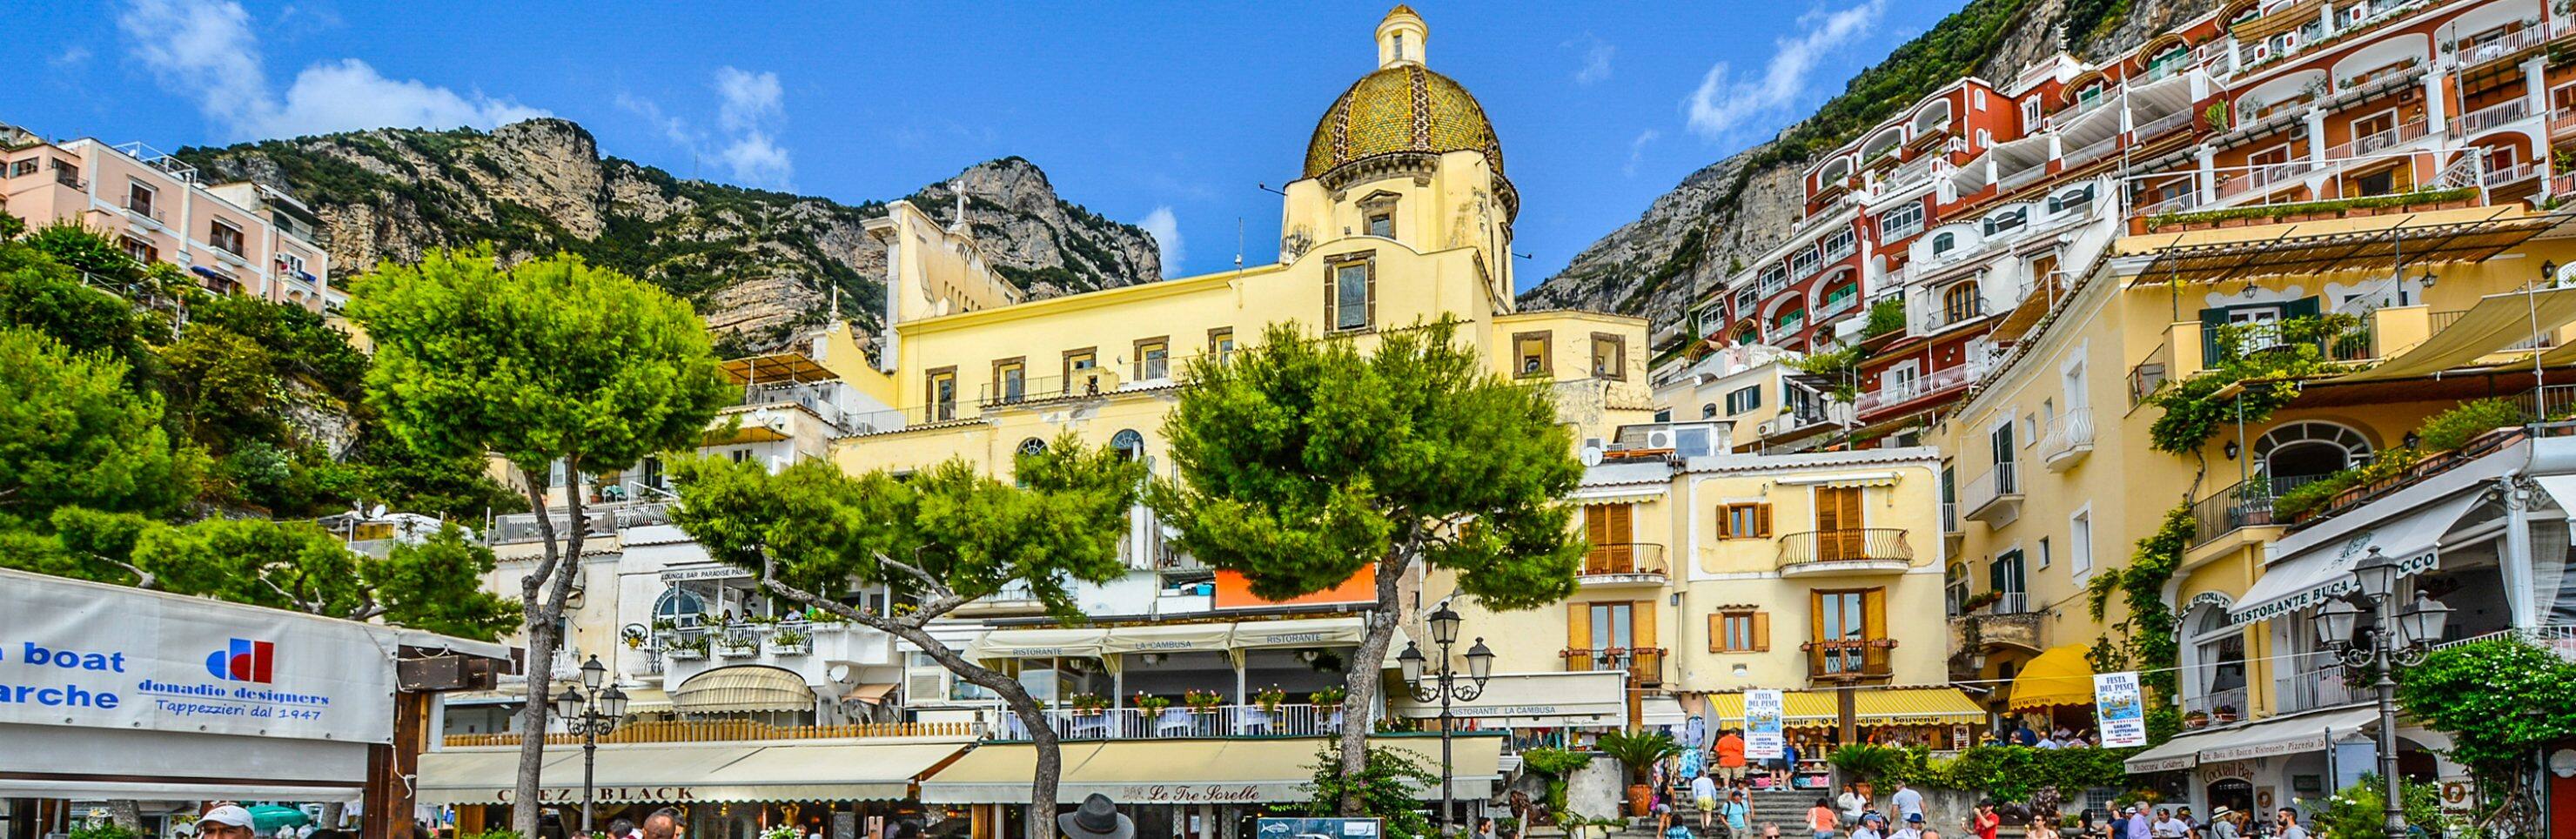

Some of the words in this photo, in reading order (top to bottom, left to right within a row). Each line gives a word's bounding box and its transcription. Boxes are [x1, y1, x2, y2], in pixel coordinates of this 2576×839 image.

[701, 569, 729, 578] PARADISE
[2232, 593, 2308, 625] RISTORANTE
[2313, 580, 2348, 601] BUCA
[2399, 553, 2435, 574] CCO
[1266, 634, 1321, 643] RISTORANTE
[1150, 641, 1192, 649] CAMBUSA
[1012, 648, 1063, 656] RISTORANTE
[24, 641, 125, 674] boat
[2107, 676, 2126, 685] FESTA
[138, 679, 226, 696] donadio
[234, 687, 330, 705] designers
[2115, 682, 2135, 692] PESCE
[156, 699, 245, 716] Tappezzieri
[251, 704, 272, 718] dal
[278, 709, 321, 722] 1947
[1451, 707, 1498, 715] RISTORANTE
[1505, 706, 1515, 715] LA
[1517, 706, 1556, 715] CAMBUSA
[2288, 741, 2314, 751] Pizzeria
[2204, 763, 2237, 782] Cocktail
[2238, 762, 2256, 782] Bar
[497, 789, 572, 802] CEZ
[600, 787, 694, 801] BLACK
[1148, 785, 1168, 801] Le
[1173, 785, 1200, 801] Tre
[1204, 784, 1260, 801] Sorelle
